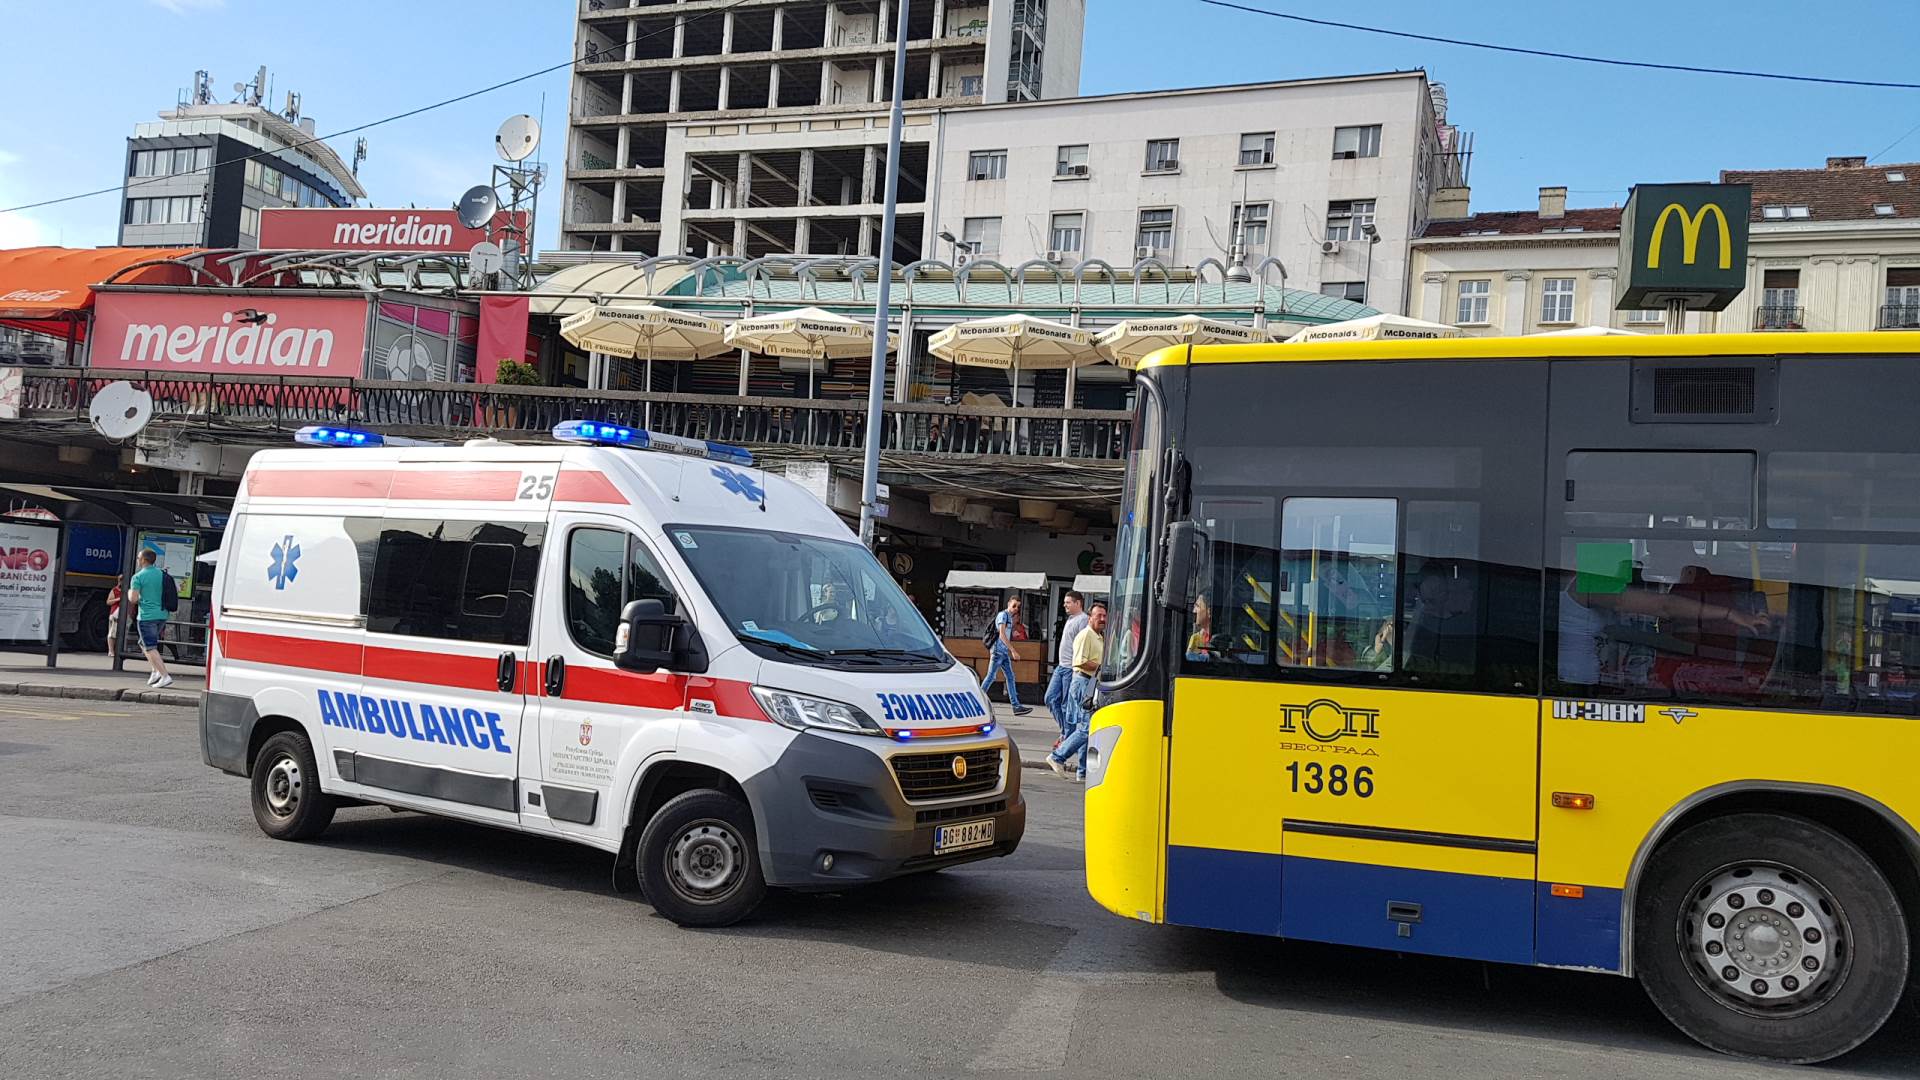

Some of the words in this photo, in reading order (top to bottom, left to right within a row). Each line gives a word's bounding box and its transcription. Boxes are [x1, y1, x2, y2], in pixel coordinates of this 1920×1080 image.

[333, 215, 453, 246] meridian
[599, 310, 645, 321] McDonald's
[667, 316, 707, 329] McDonald's
[740, 323, 780, 332] McDonald's
[801, 323, 847, 333] McDonald's
[1130, 324, 1178, 332] McDonald's
[960, 326, 1005, 335] McDonald's
[1028, 326, 1071, 339] McDonald's
[1203, 325, 1248, 338] McDonald's
[1309, 330, 1357, 340] McDonald's
[1384, 329, 1438, 339] McDonald's
[120, 311, 334, 367] meridian
[519, 475, 554, 500] 25
[86, 547, 112, 559] ВОДА
[317, 689, 512, 754] AMBULANCE
[1280, 698, 1380, 742] ГСП
[1286, 761, 1374, 798] 1386
[942, 828, 956, 846] BG
